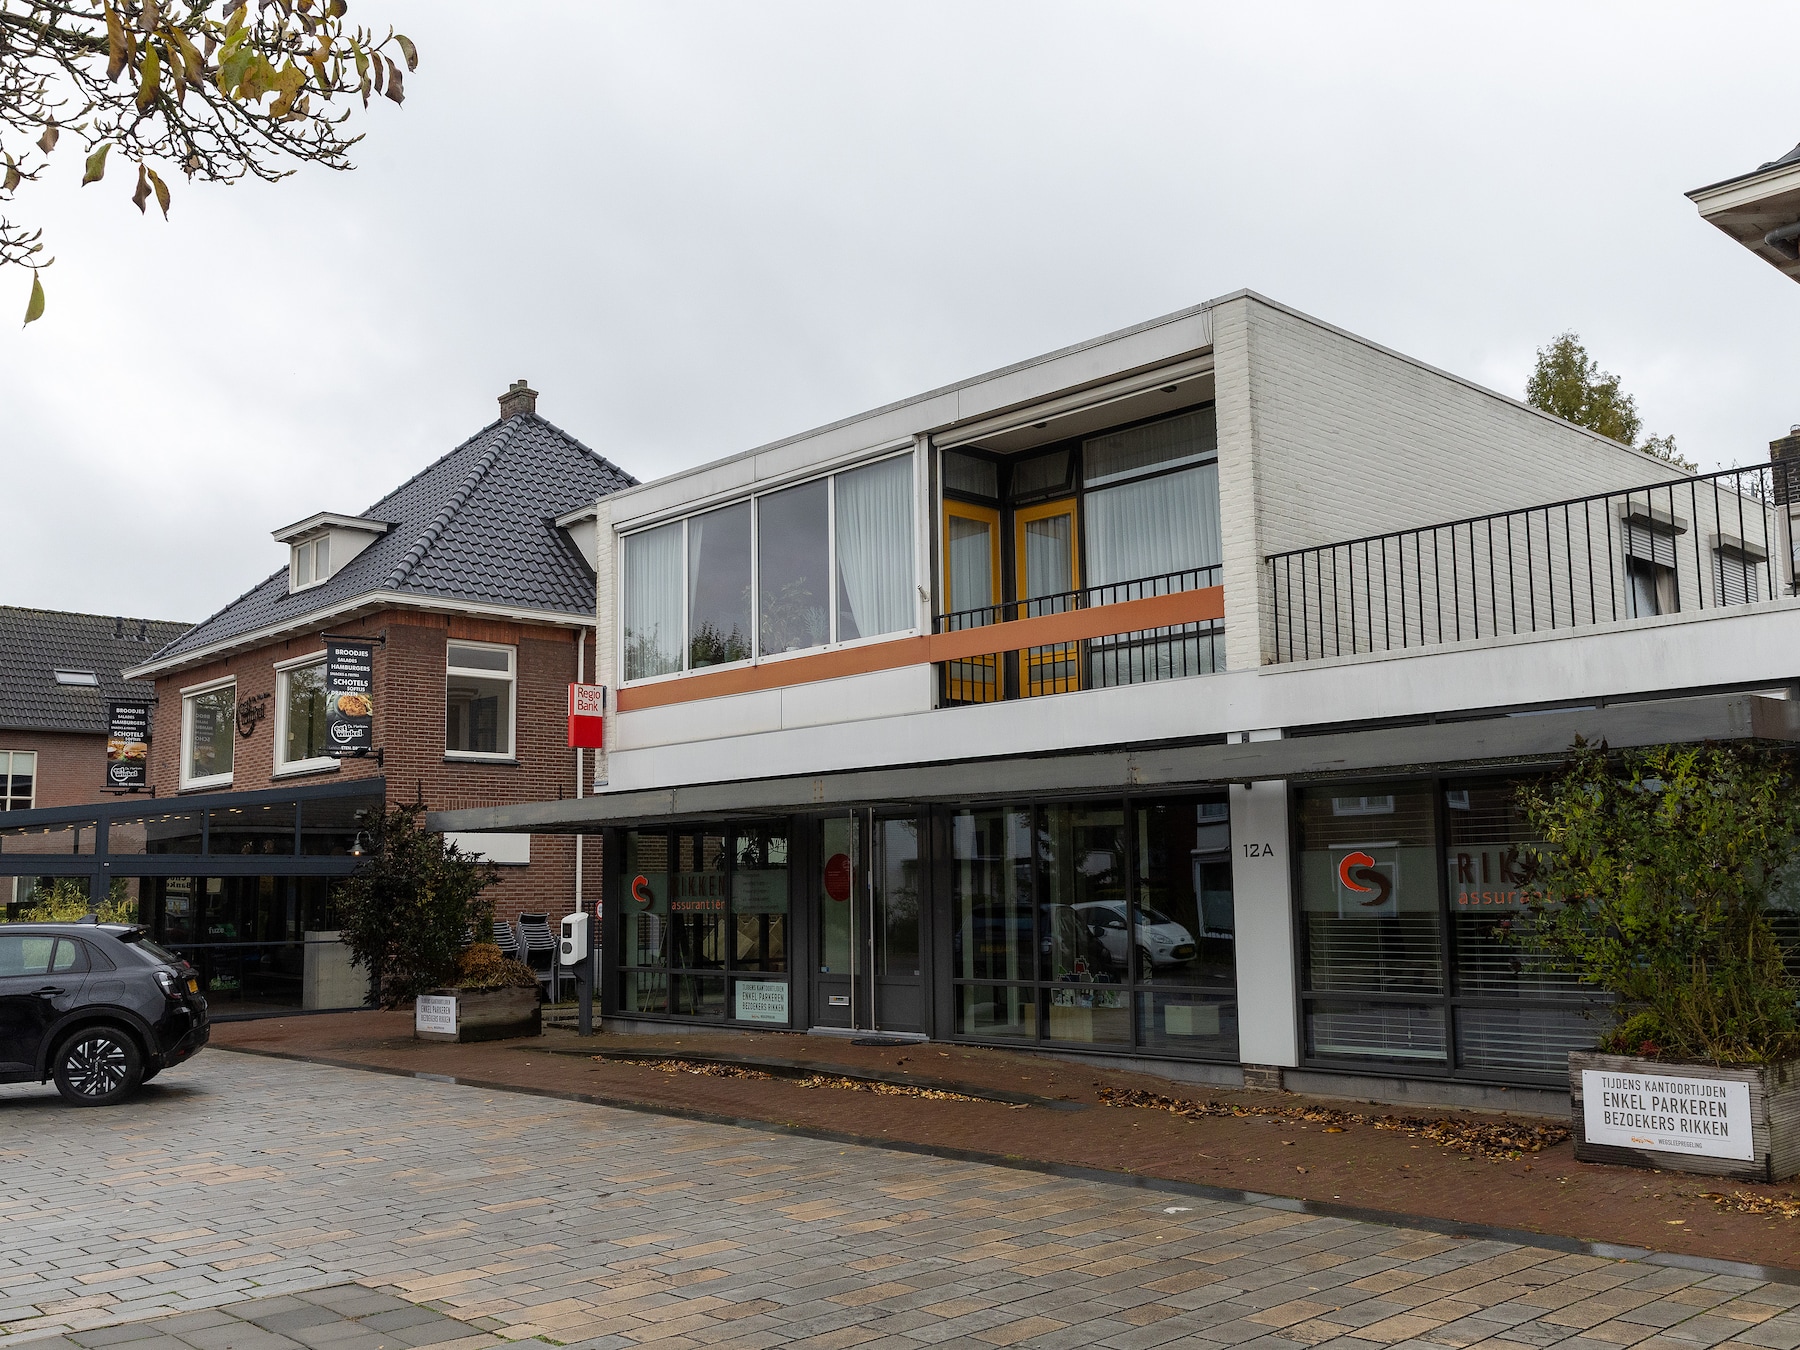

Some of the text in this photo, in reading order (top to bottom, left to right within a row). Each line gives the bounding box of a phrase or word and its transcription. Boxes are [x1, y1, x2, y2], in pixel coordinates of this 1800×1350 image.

[333, 678, 368, 687] SCHOTELS
[578, 687, 600, 701] Regio
[578, 700, 598, 711] Bank
[1243, 843, 1274, 857] 12A
[670, 876, 725, 897] RIKKEN
[1602, 1077, 1726, 1098] TIJDENS KANTOORTIJDEN
[1603, 1092, 1727, 1118] ENKEL PARKEREN
[1604, 1111, 1729, 1136] BEZOEKERS RIKKEN
[1658, 1138, 1703, 1149] WEGSLEEPREGELING
